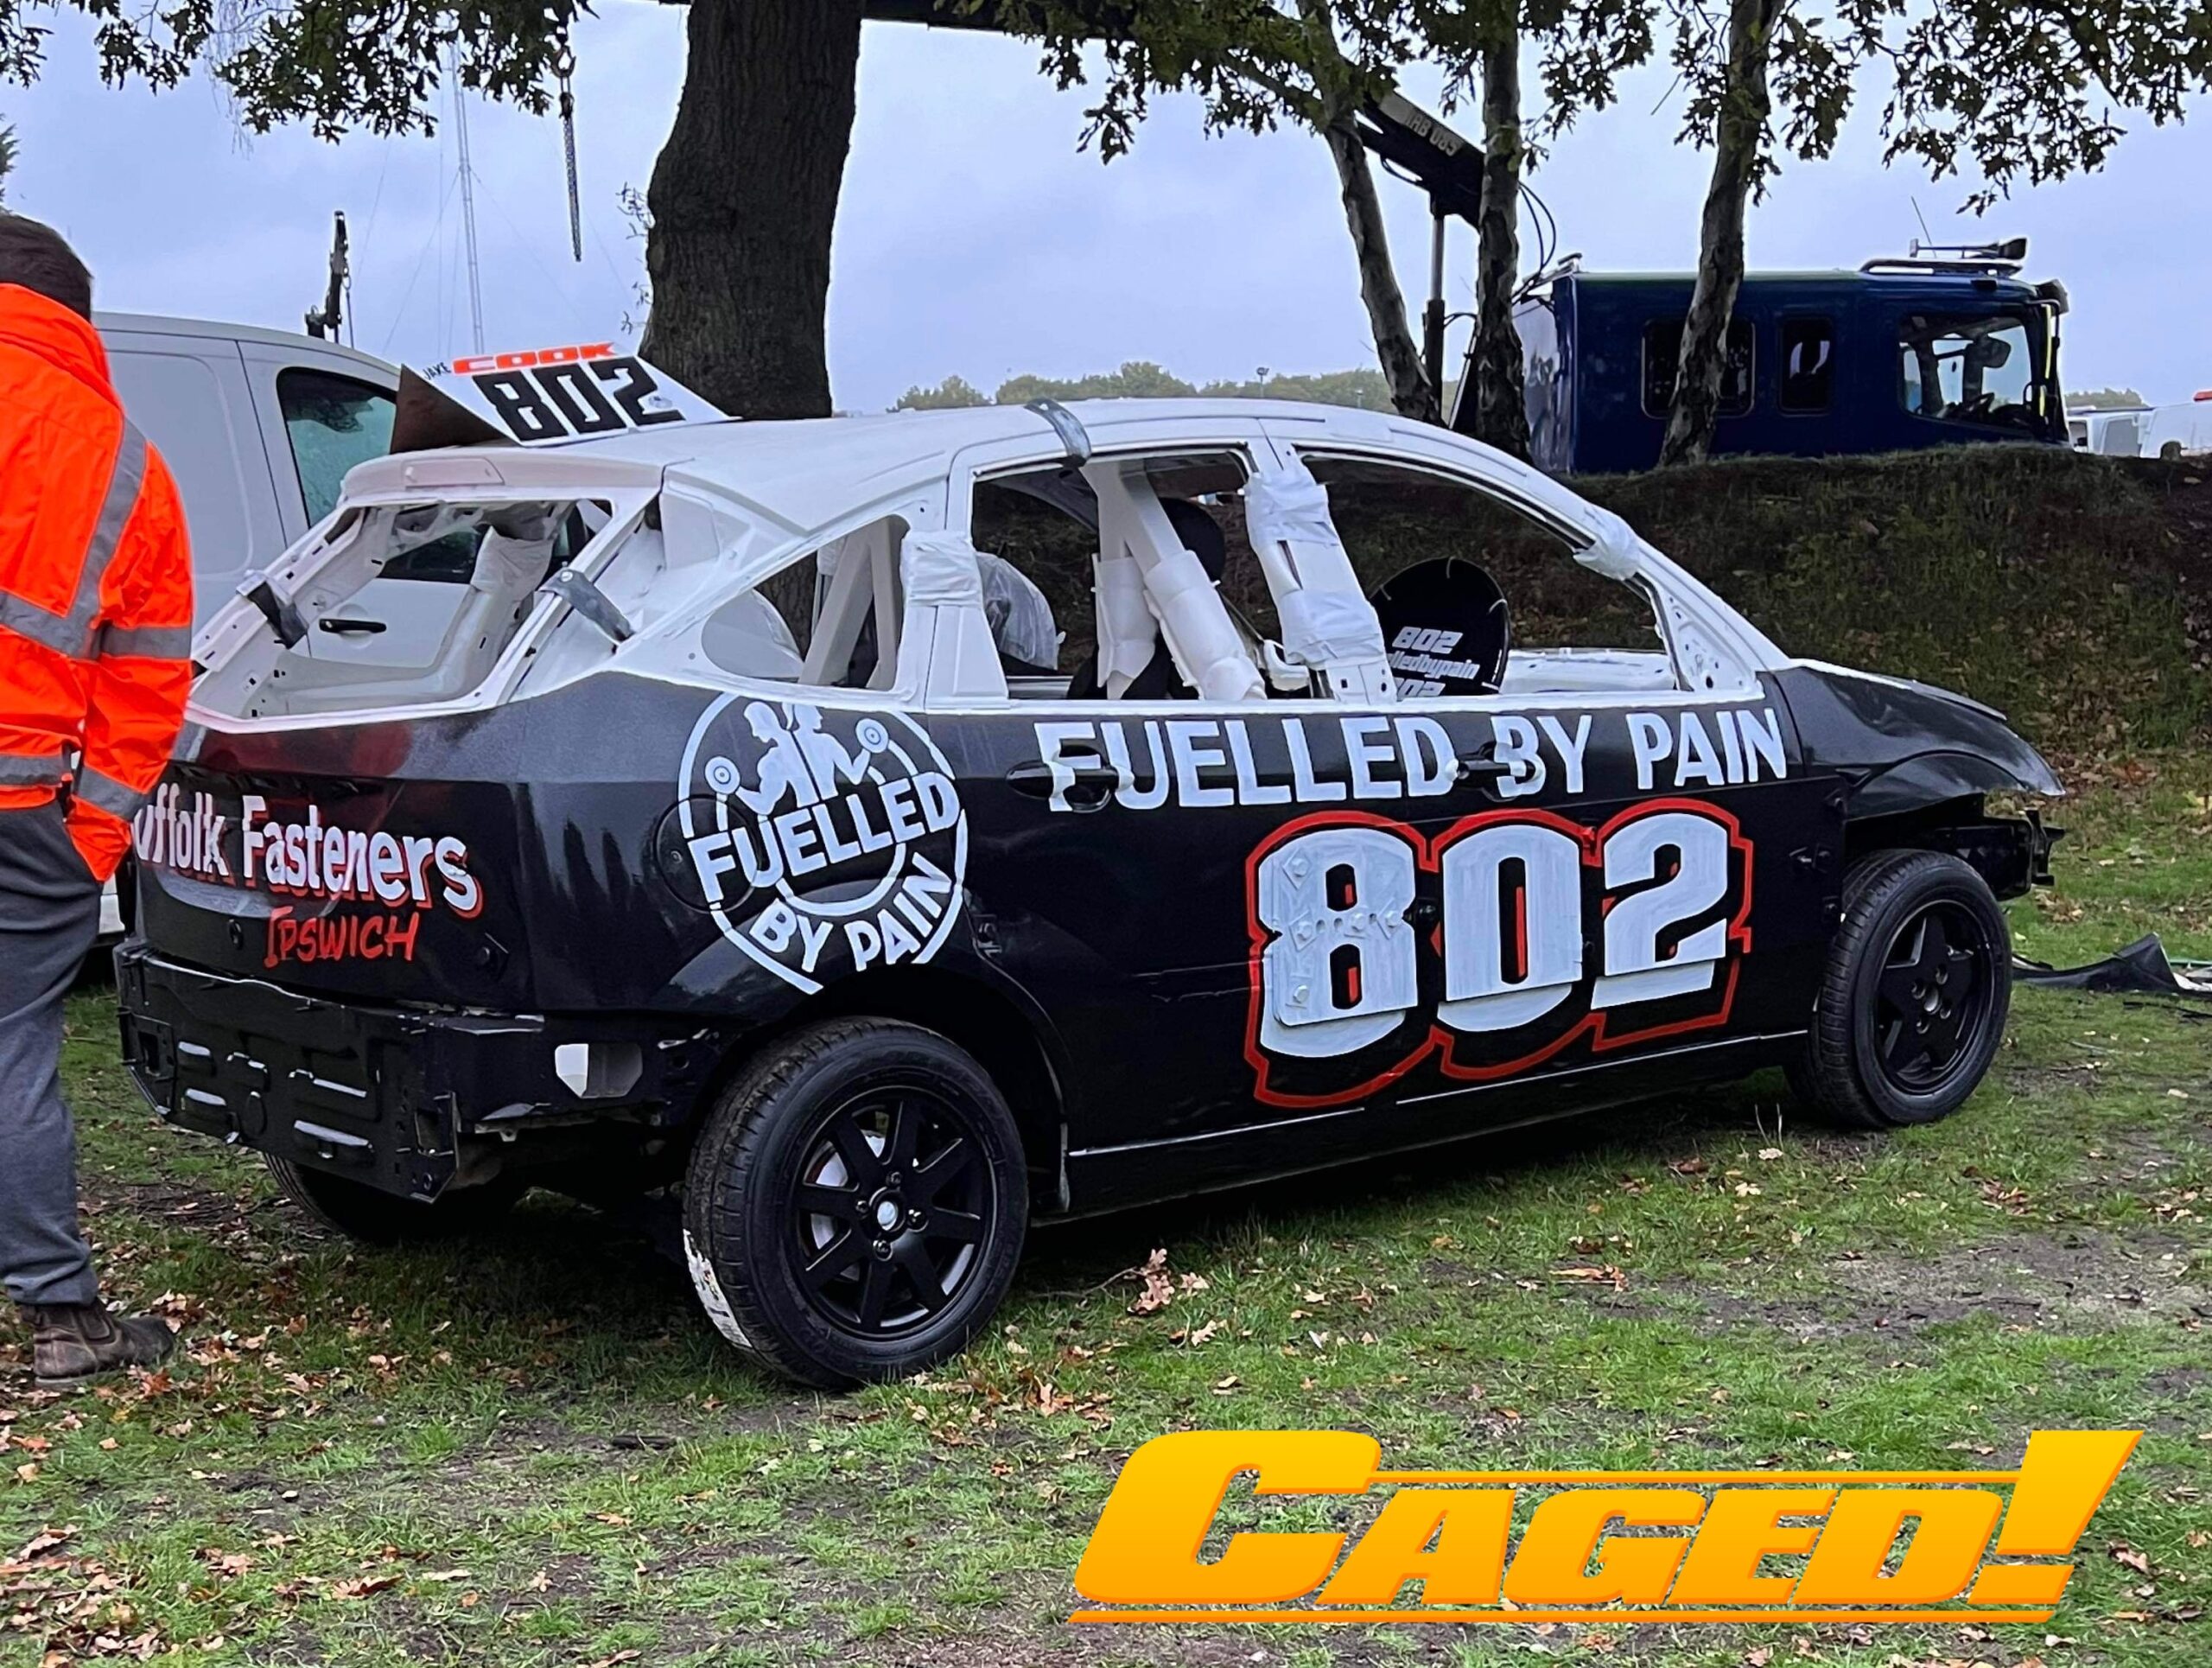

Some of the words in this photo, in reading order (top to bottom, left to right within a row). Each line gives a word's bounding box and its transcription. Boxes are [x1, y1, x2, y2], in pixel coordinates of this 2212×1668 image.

[423, 361, 452, 380] JAKE
[453, 342, 618, 375] COOK
[472, 356, 687, 442] 802
[1386, 651, 1480, 680] lledbypain
[1392, 626, 1464, 654] 802
[1033, 715, 1460, 812] FUELLED
[1492, 714, 1593, 799] BY
[1625, 709, 1788, 791] PAIN
[130, 782, 230, 876] uffolk
[242, 794, 480, 914] Fasteners
[687, 772, 961, 903] FUELLED
[749, 898, 834, 973] BY
[843, 851, 952, 972] PAIN
[1257, 811, 1729, 1059] 802
